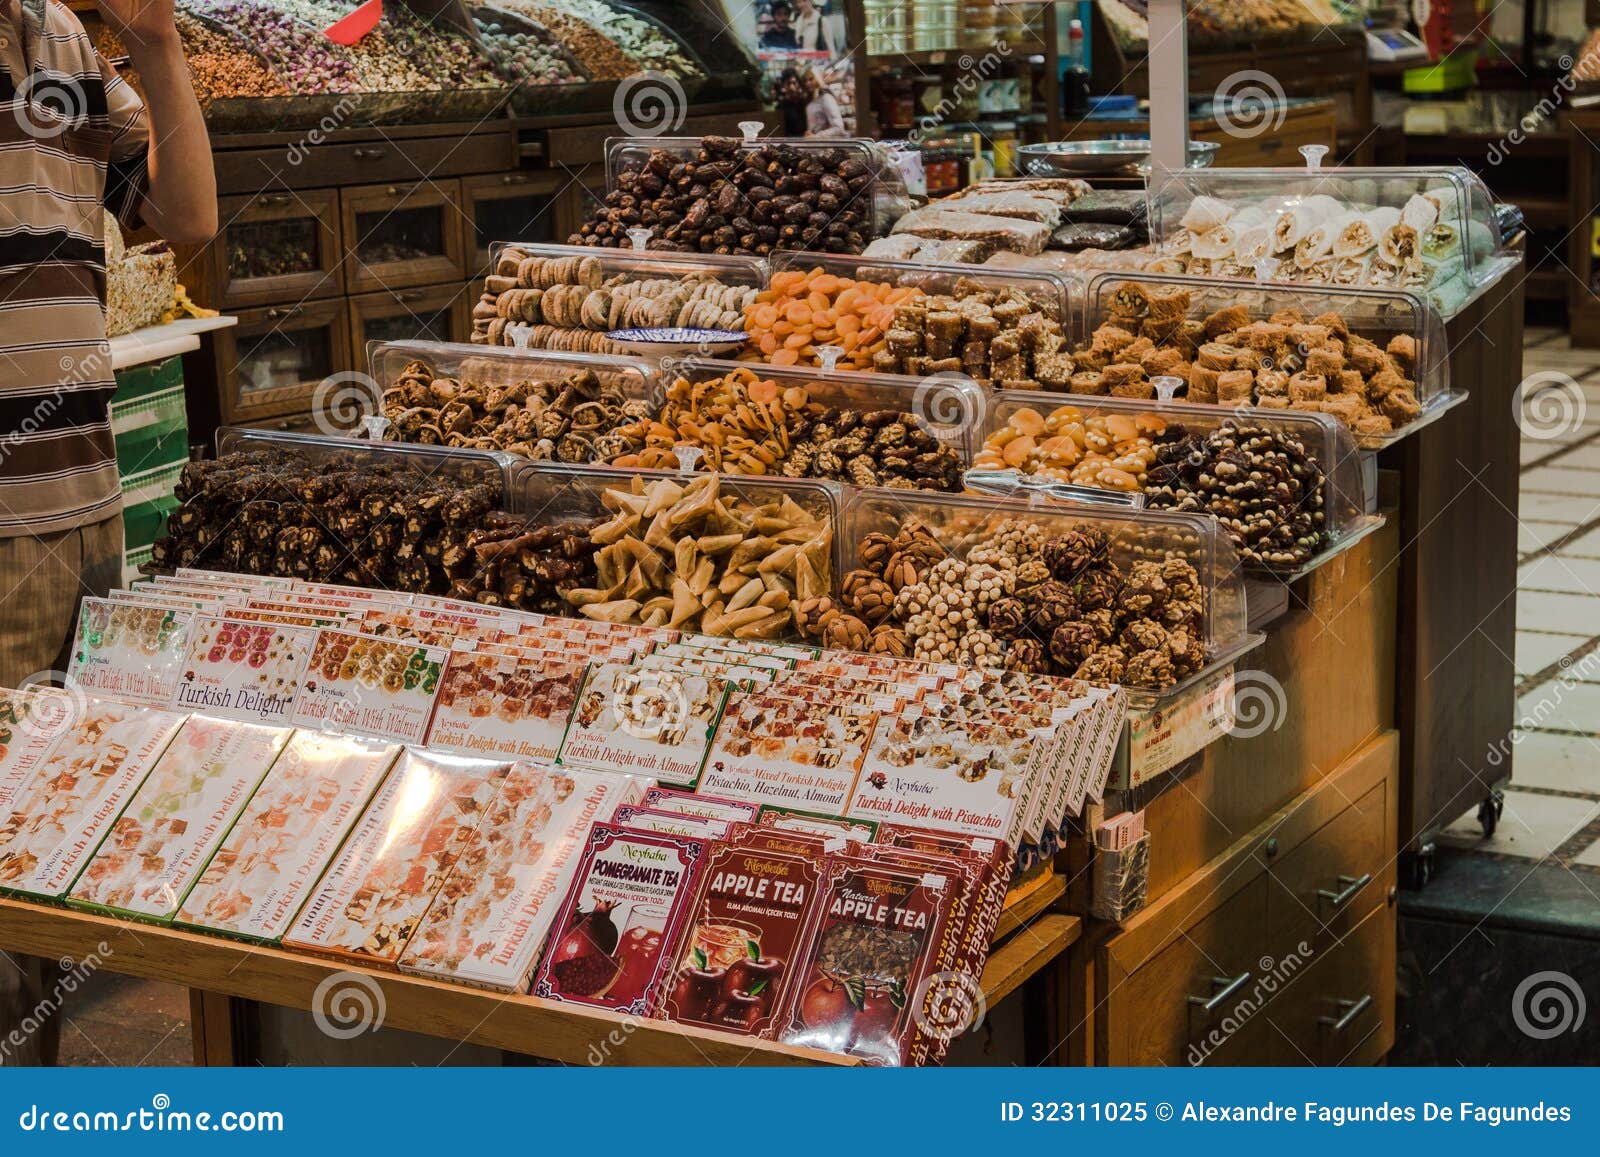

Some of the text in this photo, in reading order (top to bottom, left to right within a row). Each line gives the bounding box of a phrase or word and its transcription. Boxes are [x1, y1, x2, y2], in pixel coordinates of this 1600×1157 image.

[177, 682, 286, 718] Turkish Delight
[432, 729, 465, 748] Turkish
[465, 734, 498, 753] Delight
[498, 739, 517, 753] with
[517, 741, 559, 759] Hazelnut
[564, 741, 699, 776] Turkish Delight with Almond
[1073, 704, 1107, 805] Turkish Delight
[705, 774, 752, 793] Pistachio,
[753, 782, 801, 800] Hazelnut,
[802, 788, 845, 805] Almond
[753, 768, 781, 781] Mixed
[781, 772, 814, 786] Turkish
[814, 777, 848, 793] Delight
[1031, 730, 1069, 833] Turkish Delight
[1051, 718, 1088, 820] Turkish Delight
[1092, 744, 1113, 793] Turkish
[855, 794, 1002, 829] Turkish Delight with Pistachio
[1008, 742, 1045, 845] Turkish Delight
[45, 837, 87, 892] Turkish
[81, 789, 122, 841] Delight
[115, 762, 140, 792] with
[179, 821, 217, 870] Turkish
[211, 776, 248, 824] Delight
[260, 877, 303, 933] Turkish
[329, 797, 354, 829] with
[491, 913, 530, 966] Turkish
[525, 872, 559, 925] Delight
[563, 784, 608, 847] Pistachio
[592, 859, 679, 887] POMEGRANATE TEA
[621, 845, 668, 862] Neybaba
[336, 854, 371, 900] Turkish
[710, 871, 805, 905] APPLE TEA
[841, 888, 879, 903] Natural
[307, 896, 343, 942] Delight
[726, 902, 741, 910] ELMA
[741, 904, 765, 915] AROMALI
[783, 911, 798, 920] TOZU
[830, 898, 926, 930] APPLE TEA
[936, 897, 959, 967] NATURAL
[941, 888, 971, 972] NATUREL
[962, 883, 987, 951] NATURAL
[937, 873, 999, 1057] NATUREL APPLE TEA
[922, 974, 938, 1014] ELMA
[922, 978, 946, 1040] APPLE
